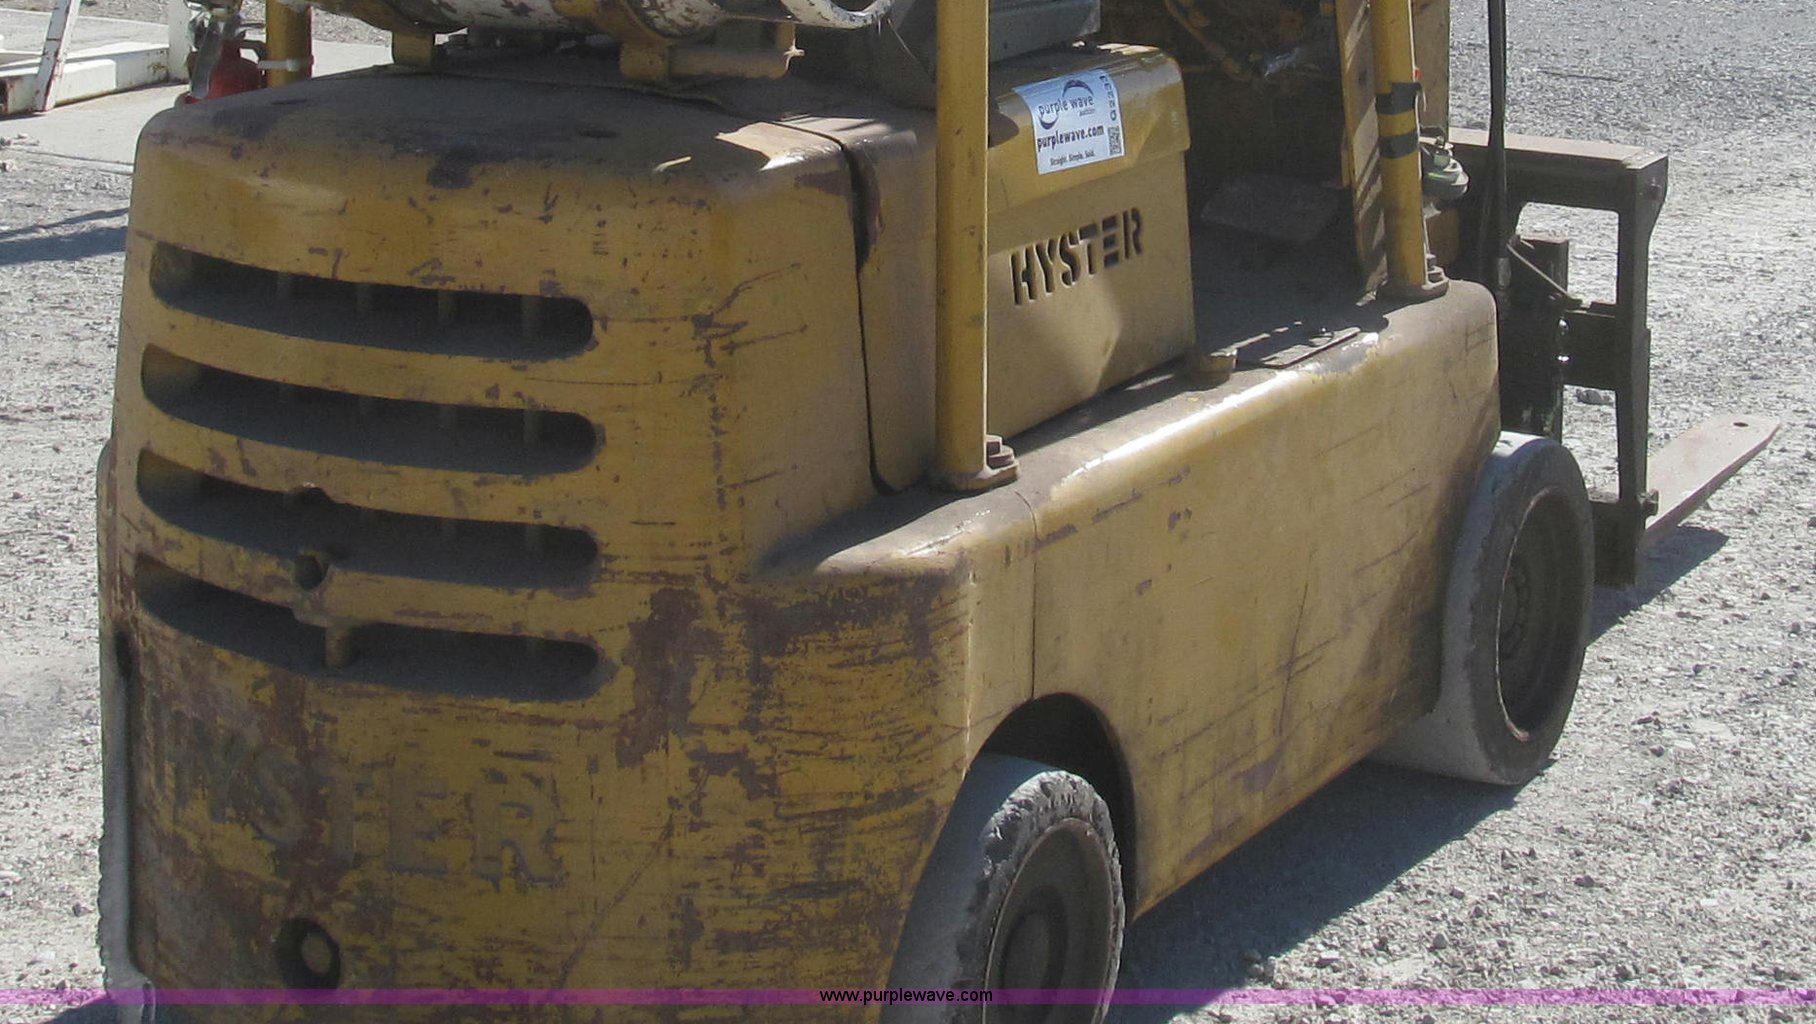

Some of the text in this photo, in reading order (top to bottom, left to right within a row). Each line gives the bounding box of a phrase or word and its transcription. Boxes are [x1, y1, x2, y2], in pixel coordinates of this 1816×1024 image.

[1038, 97, 1068, 116] purple
[1070, 95, 1094, 109] wave
[1037, 125, 1104, 152] purplewave.com
[1010, 207, 1142, 305] HYSTER
